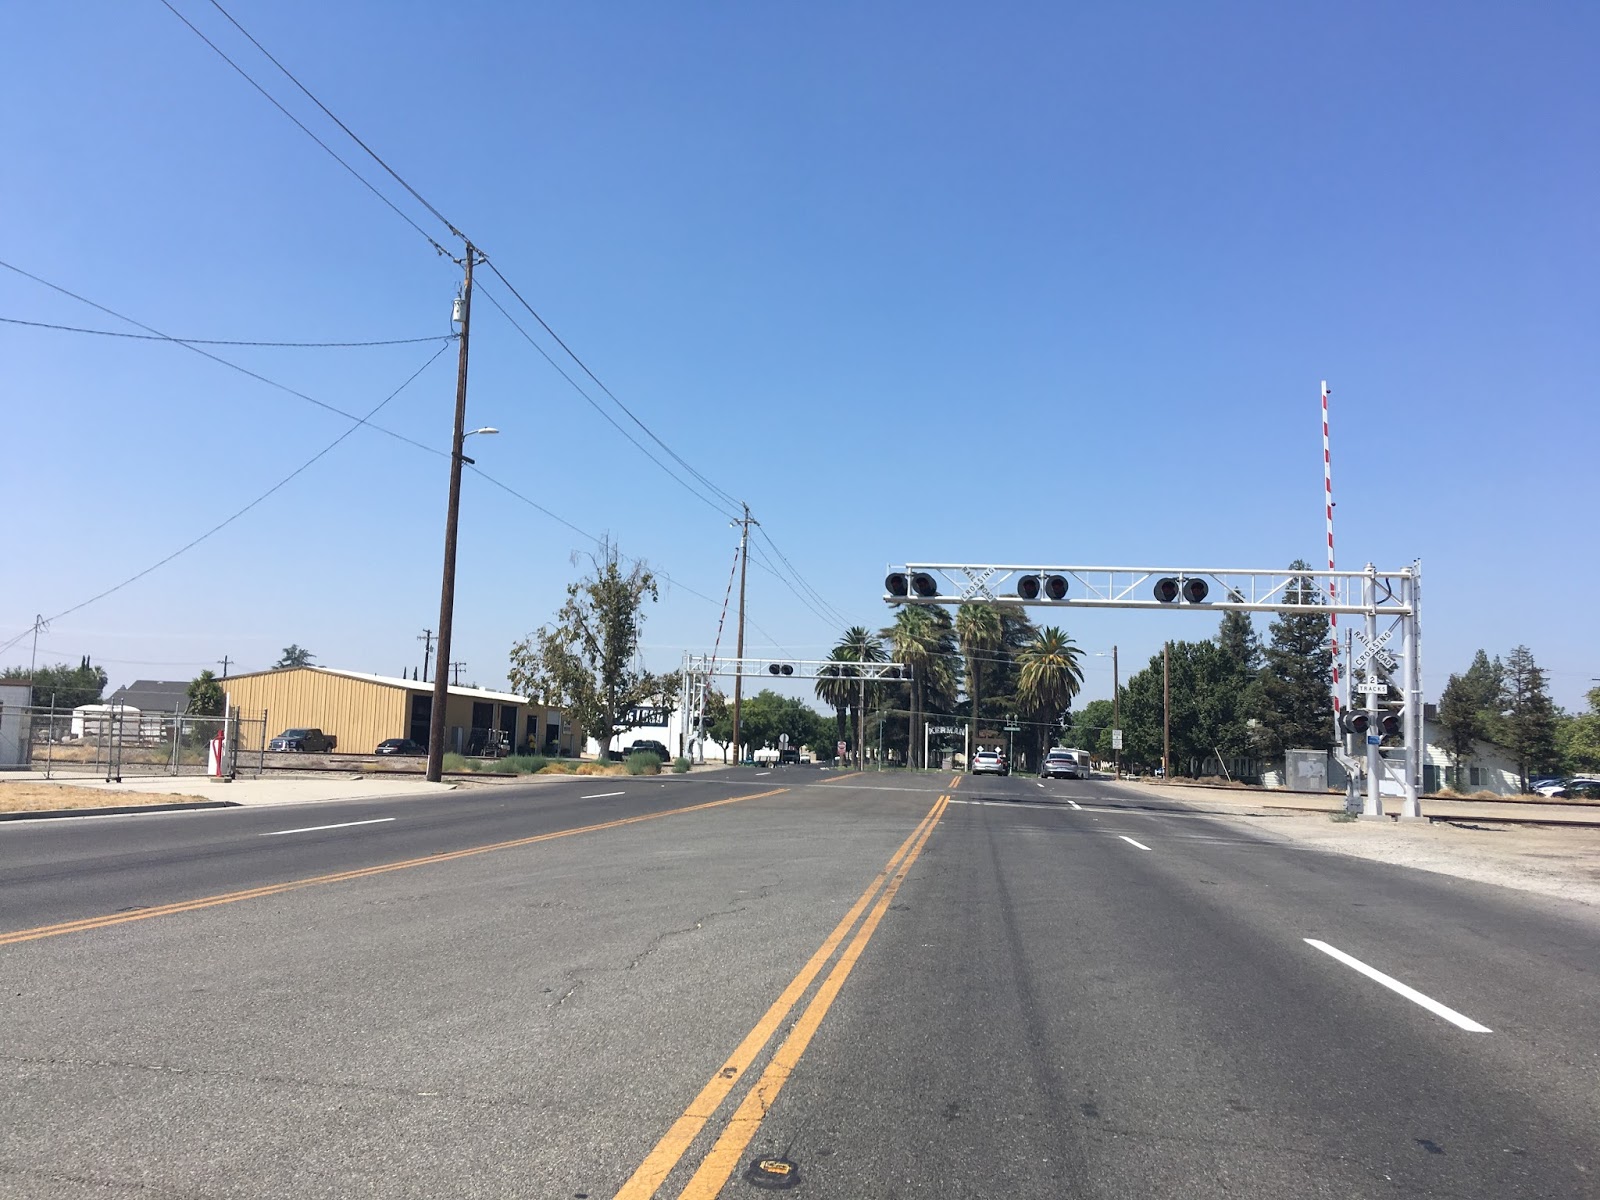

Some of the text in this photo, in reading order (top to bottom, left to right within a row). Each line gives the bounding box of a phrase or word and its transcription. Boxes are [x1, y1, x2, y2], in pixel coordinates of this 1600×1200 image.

[961, 566, 994, 600] RAIL ROAD
[961, 567, 995, 599] CROSSING
[1354, 630, 1392, 666] RAIL ROAD
[1355, 631, 1392, 666] CROSSING
[1369, 676, 1376, 684] 2
[928, 726, 965, 736] KERMAN
